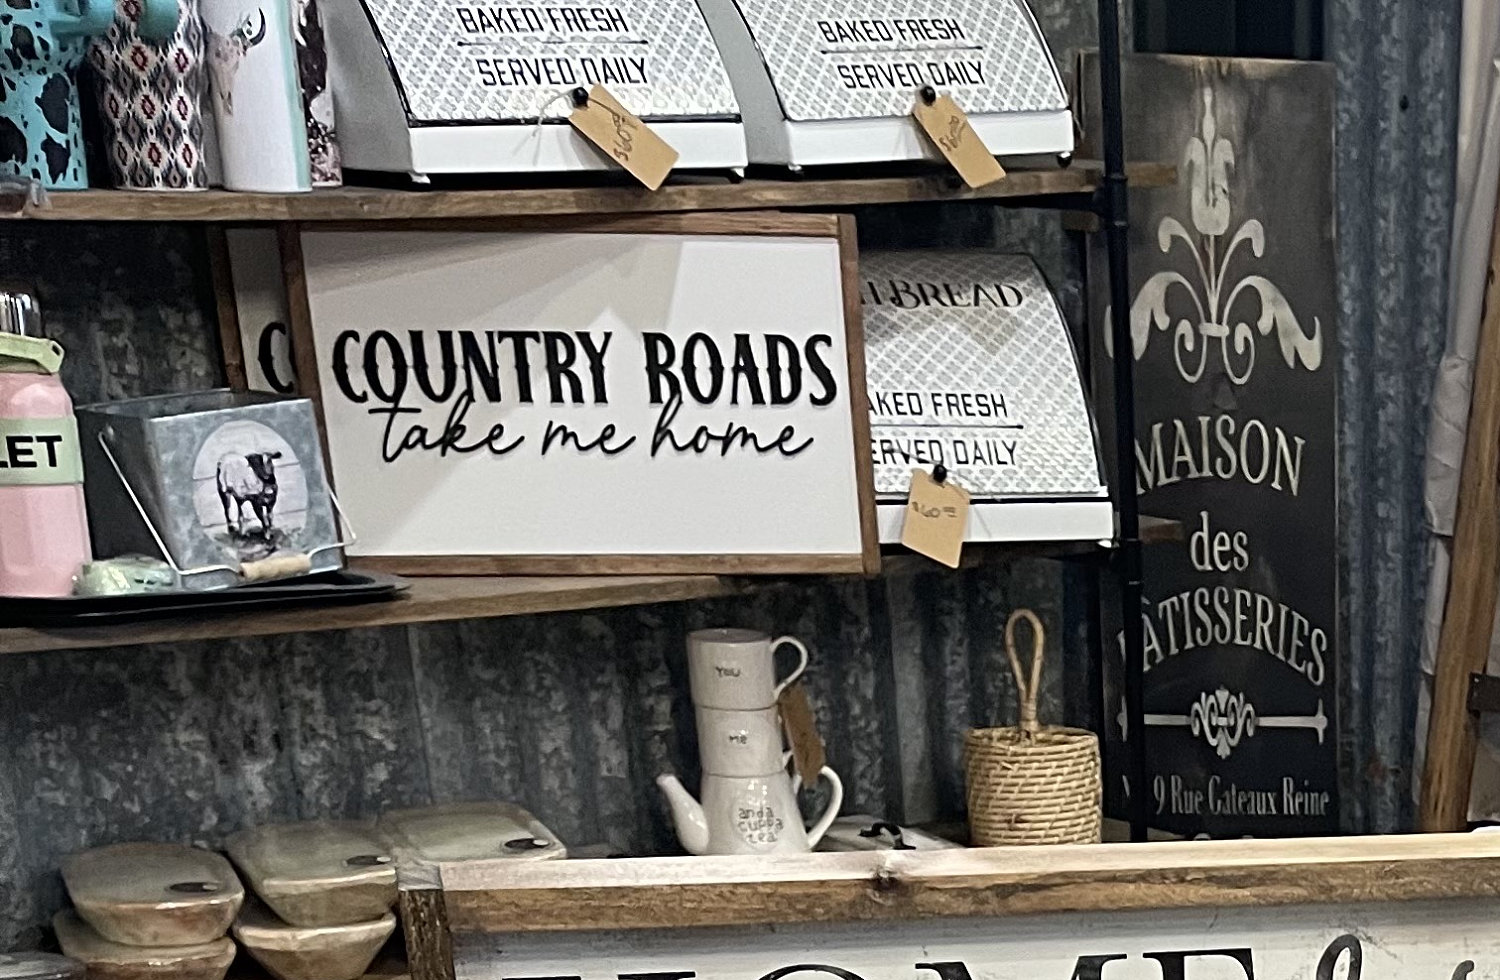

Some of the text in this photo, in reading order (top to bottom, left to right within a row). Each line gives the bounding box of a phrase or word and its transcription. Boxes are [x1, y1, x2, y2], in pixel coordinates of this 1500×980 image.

[456, 7, 629, 33] BAKED FRESH
[817, 18, 965, 43] BAKED FRESH
[476, 57, 648, 86] SERVED DAILY
[837, 61, 986, 89] SERVED DAILY
[889, 280, 1024, 310] BREAD
[332, 329, 838, 407] COUNTRY ROADS
[868, 391, 1008, 418] AKED FRESH
[368, 389, 814, 463] take me home
[870, 438, 1017, 466] ERVED DAILY
[1134, 414, 1306, 496] MAISON
[1190, 510, 1249, 572] des
[1170, 774, 1204, 816] Rue
[1282, 776, 1330, 816] Reine
